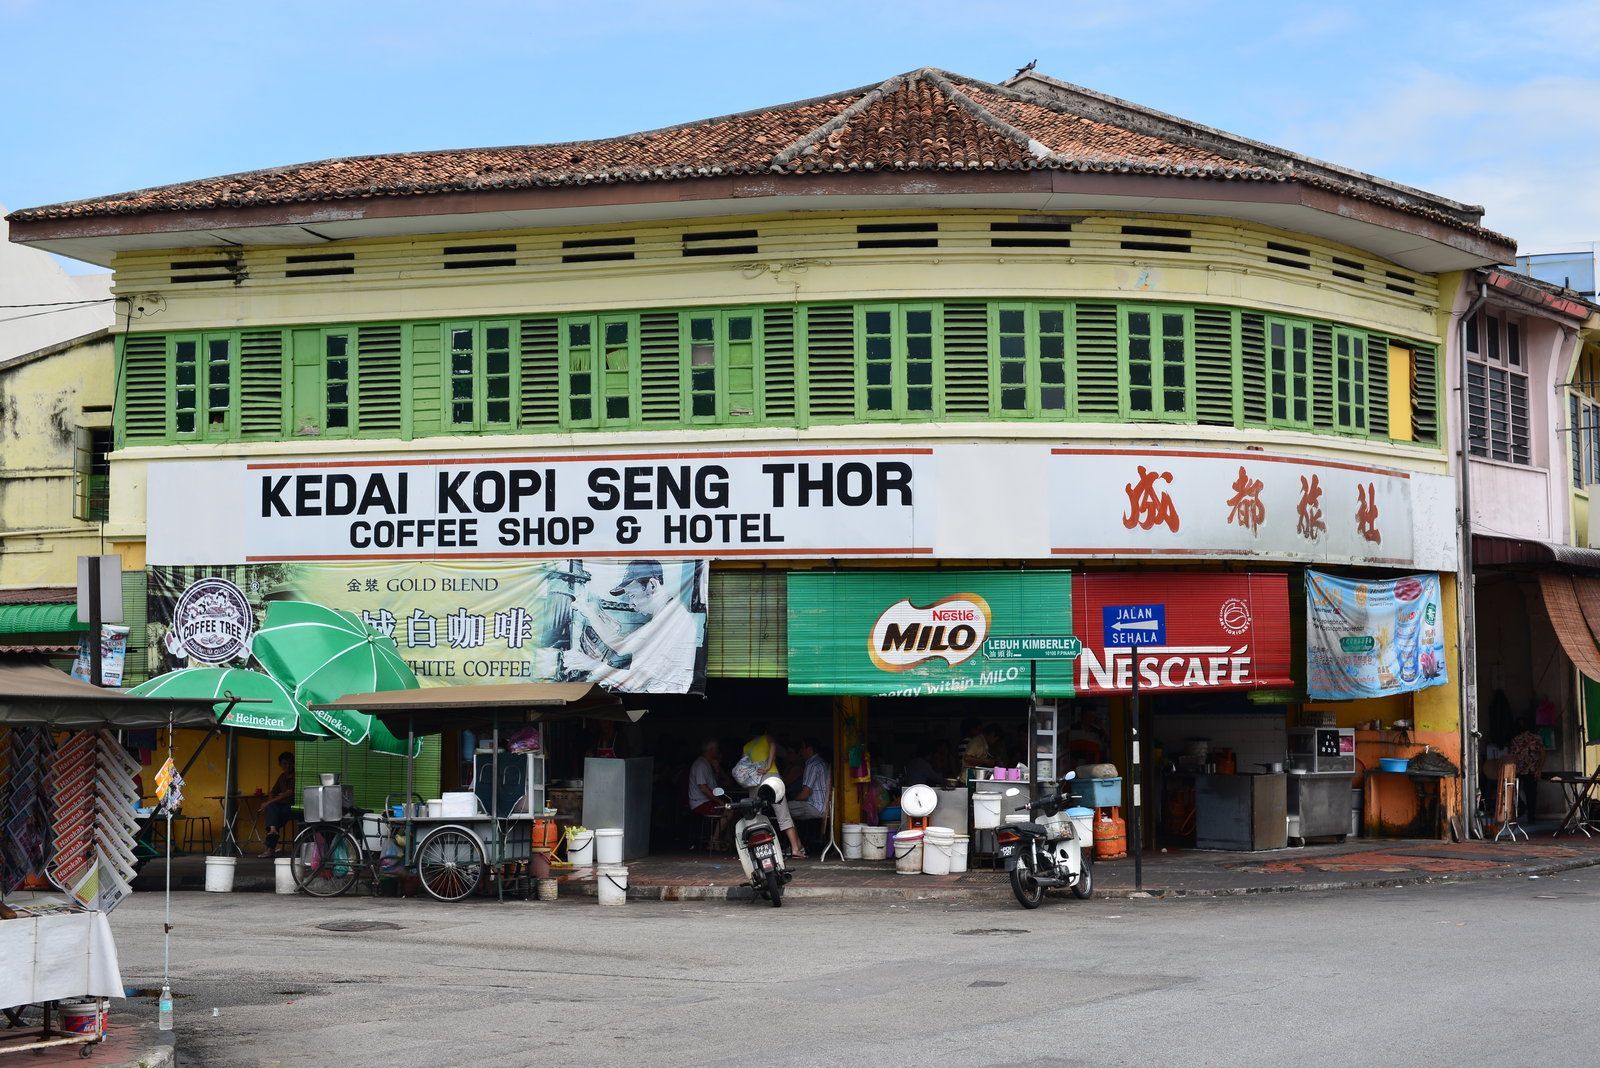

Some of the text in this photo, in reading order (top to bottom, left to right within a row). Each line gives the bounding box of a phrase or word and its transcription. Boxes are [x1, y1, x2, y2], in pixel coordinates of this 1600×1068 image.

[261, 461, 913, 517] KEDAI KOPI SENG THOR
[349, 513, 785, 548] COFFEE SHOP & HOTEL
[346, 578, 380, 593] 金裝
[386, 577, 499, 592] GOLD BLEND
[932, 609, 974, 622] Nestlé
[1116, 608, 1152, 620] JALAN
[183, 620, 242, 640] COFFEE TREE
[881, 622, 977, 652] MILO
[1112, 633, 1158, 644] SEHALA
[988, 639, 1076, 650] LEBUH KIMBERLEY
[463, 660, 531, 677] COFFEE
[1080, 644, 1253, 690] NESCAFÉ
[927, 677, 974, 695] within
[979, 666, 1019, 687] MILO
[236, 712, 284, 727] Heineken
[58, 810, 84, 832] Harakah
[58, 825, 85, 848] Harakah
[58, 840, 84, 864] Harakah
[57, 856, 83, 879] Harakah
